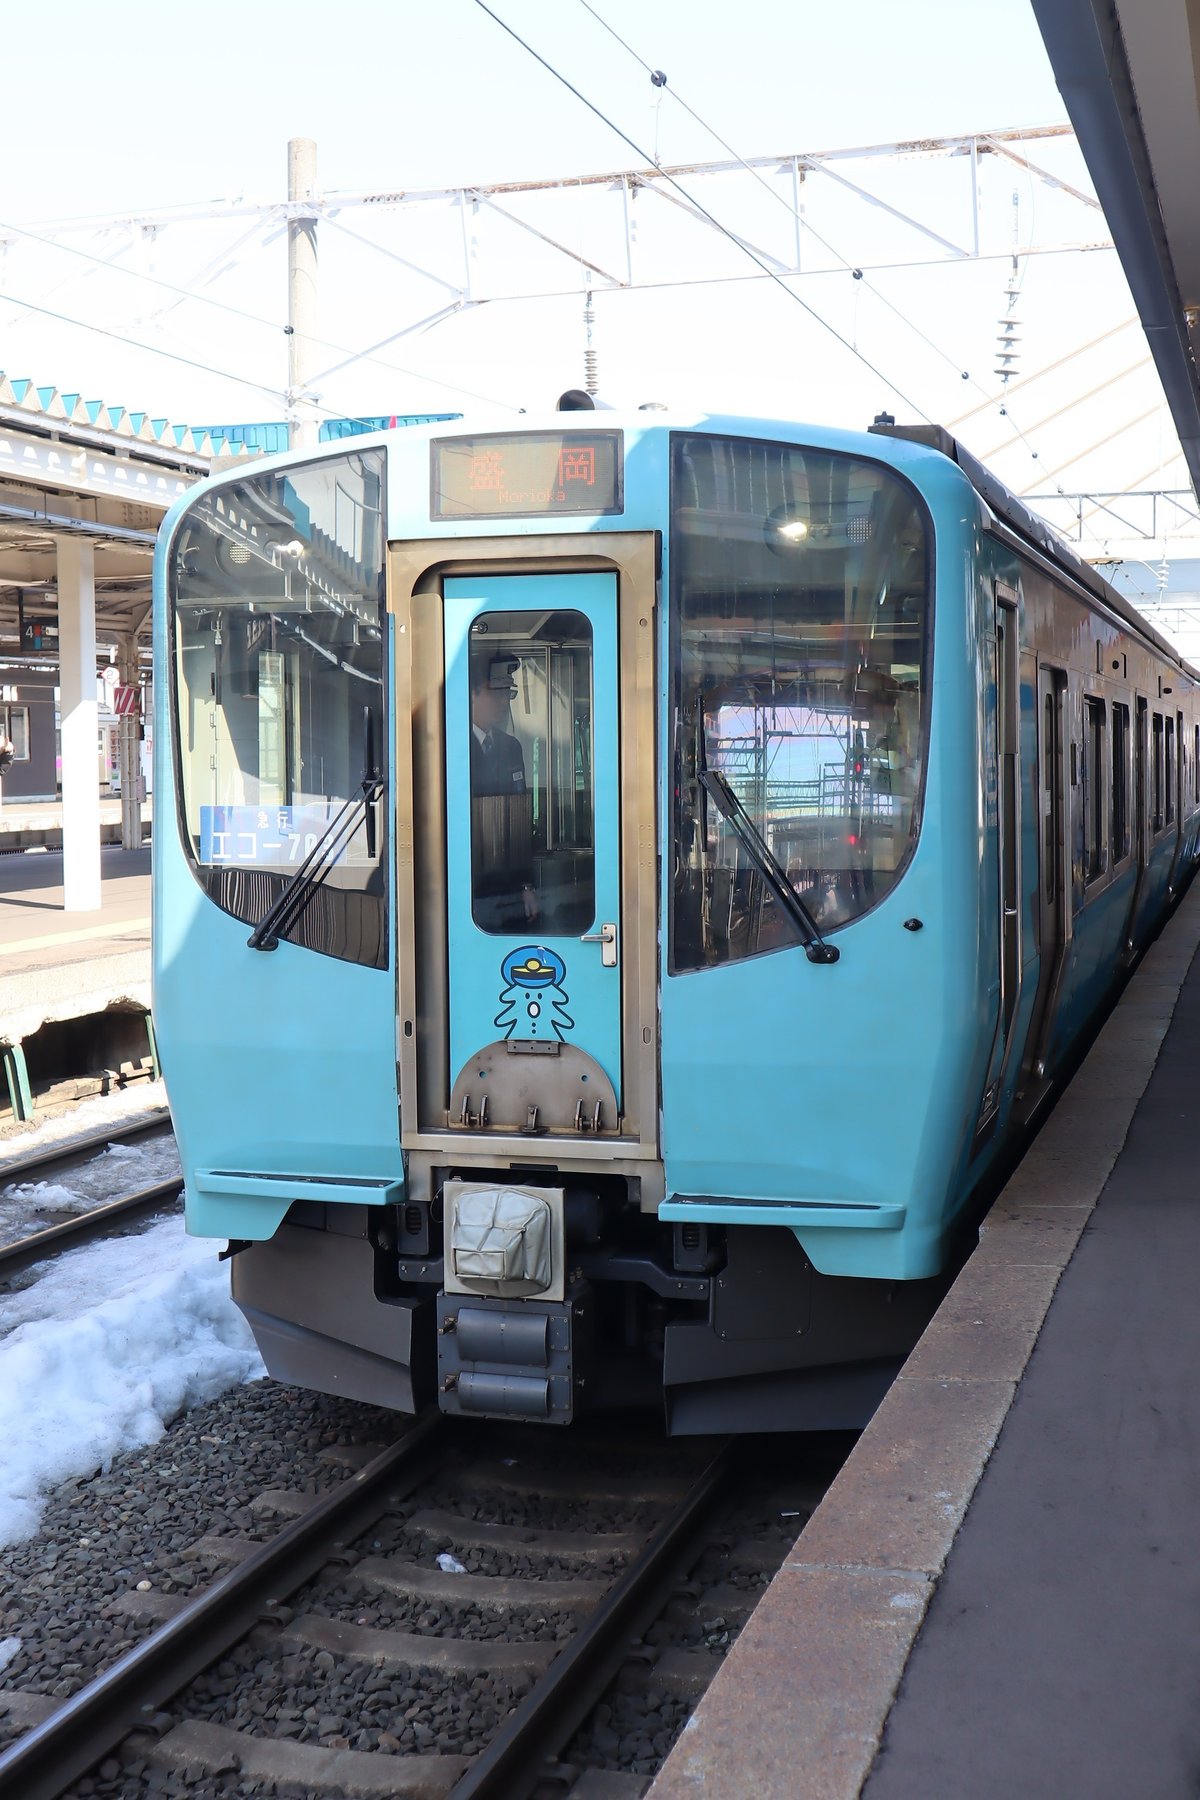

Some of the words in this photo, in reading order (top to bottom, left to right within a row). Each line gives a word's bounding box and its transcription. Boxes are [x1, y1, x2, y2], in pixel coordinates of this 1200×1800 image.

[469, 448, 595, 490] 盛岡
[25, 625, 34, 639] 4
[257, 811, 288, 829] 急行
